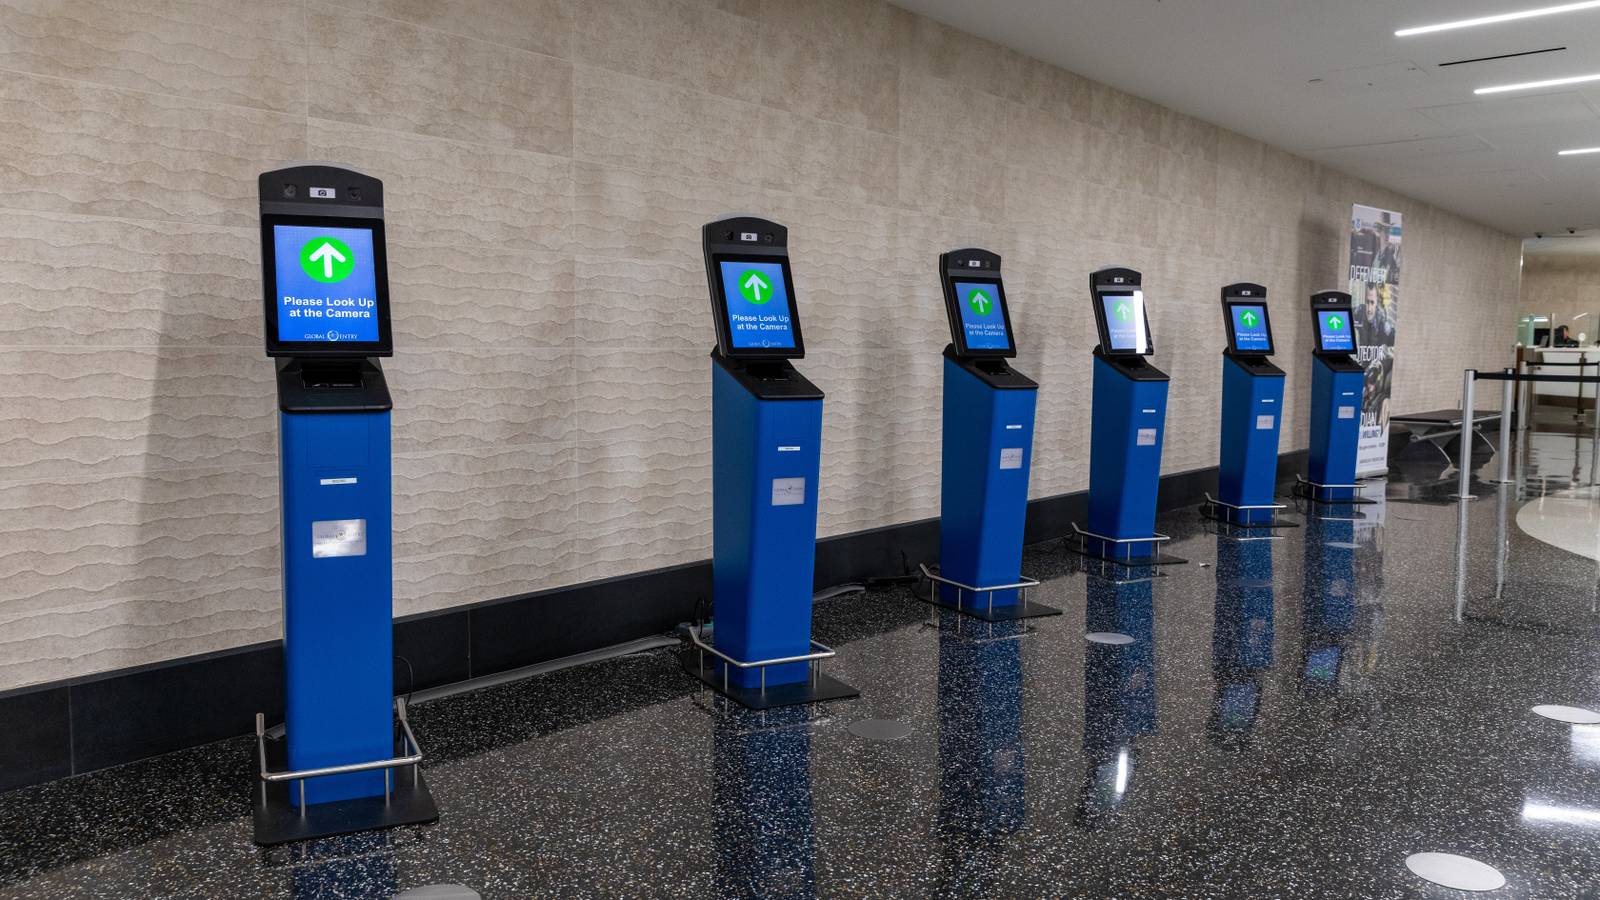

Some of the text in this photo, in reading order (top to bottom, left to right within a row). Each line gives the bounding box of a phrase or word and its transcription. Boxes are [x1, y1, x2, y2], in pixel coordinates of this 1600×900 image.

[283, 296, 375, 309] Please Look Up
[289, 308, 371, 319] at the Camera
[732, 314, 790, 324] Please Look Up
[759, 323, 788, 331] Camera
